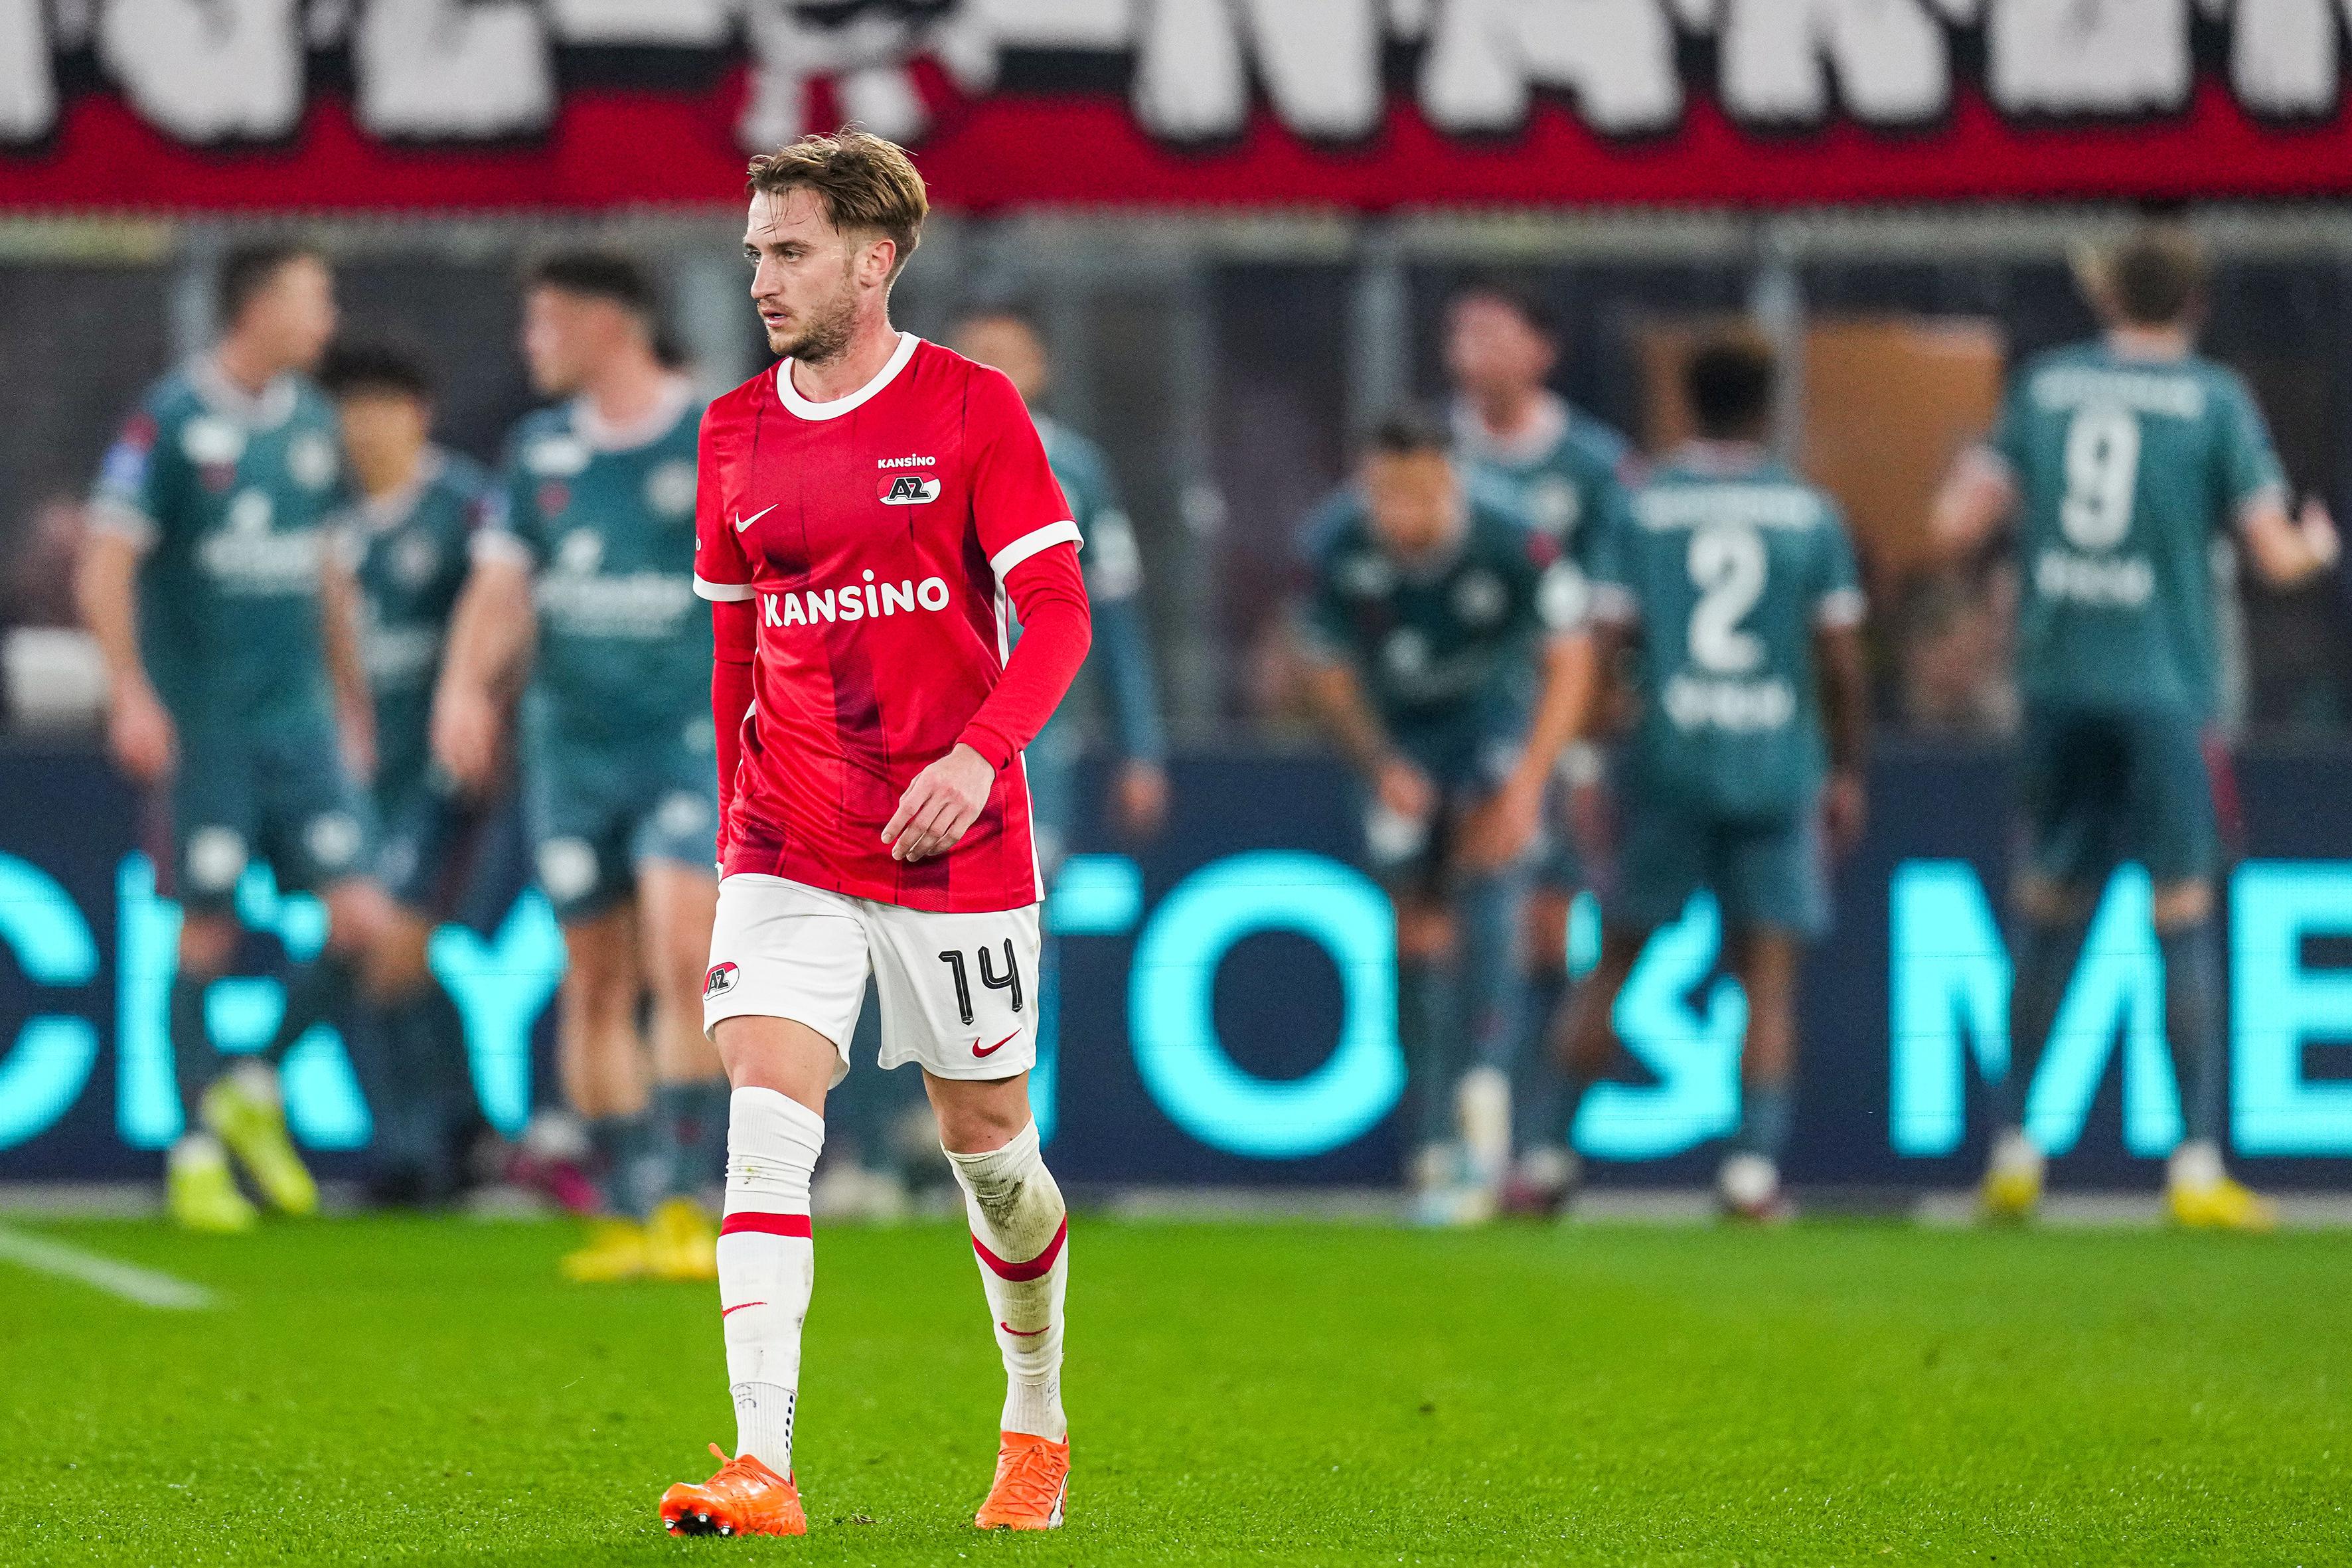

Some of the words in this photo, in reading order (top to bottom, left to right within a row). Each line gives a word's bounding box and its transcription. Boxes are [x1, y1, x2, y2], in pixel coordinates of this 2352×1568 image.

[888, 477, 931, 501] AZ
[2063, 406, 2140, 548] 9
[1688, 526, 1767, 669] 2
[708, 969, 730, 995] AZ
[938, 937, 1023, 1026] 14
